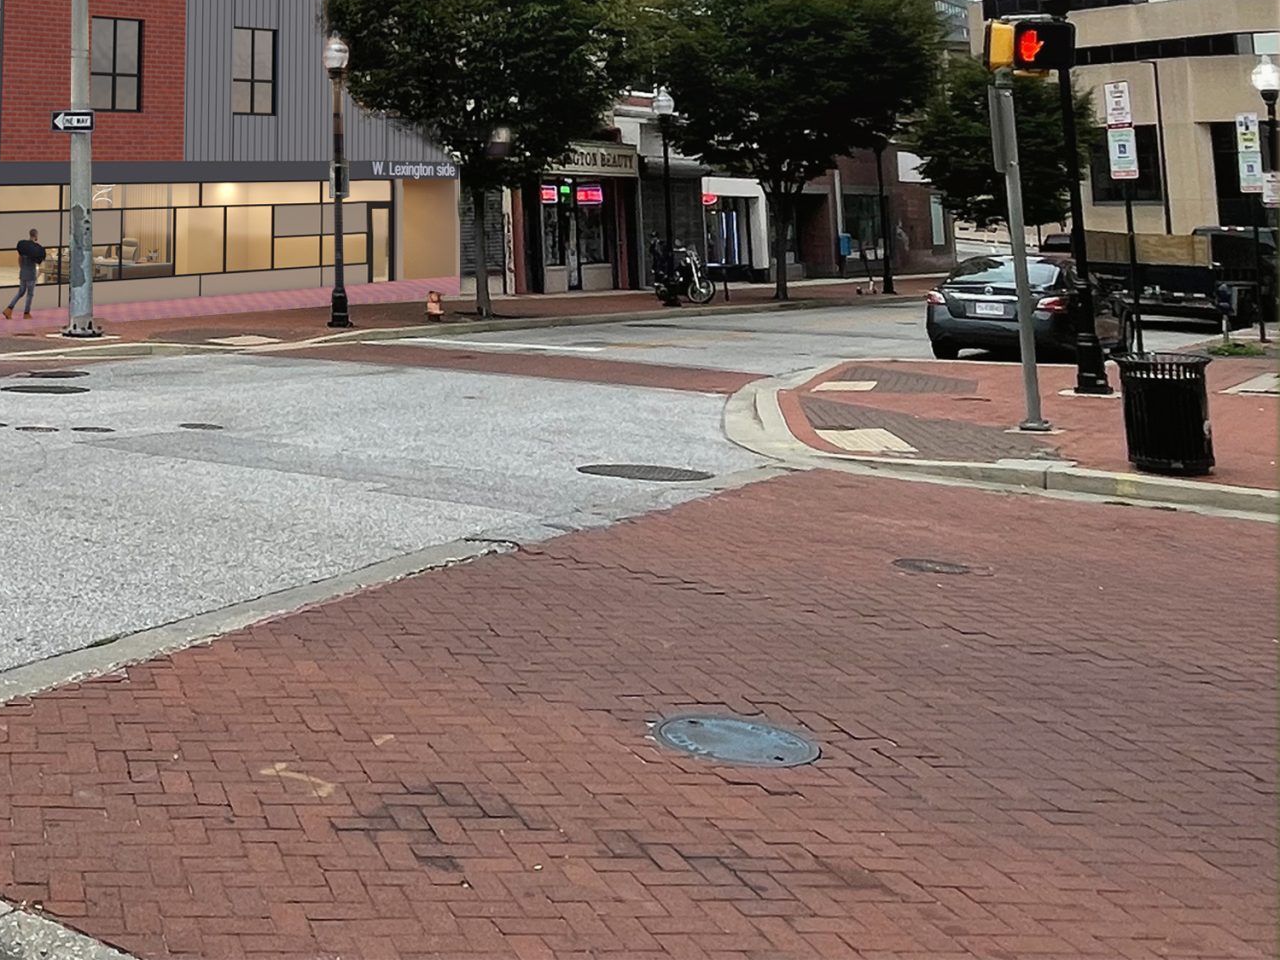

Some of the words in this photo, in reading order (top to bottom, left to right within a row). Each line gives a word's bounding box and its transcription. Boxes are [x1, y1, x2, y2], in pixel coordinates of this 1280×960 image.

[600, 151, 634, 170] BEAUTY
[372, 161, 386, 176] W.
[388, 161, 434, 179] Lexington
[436, 162, 456, 177] side
